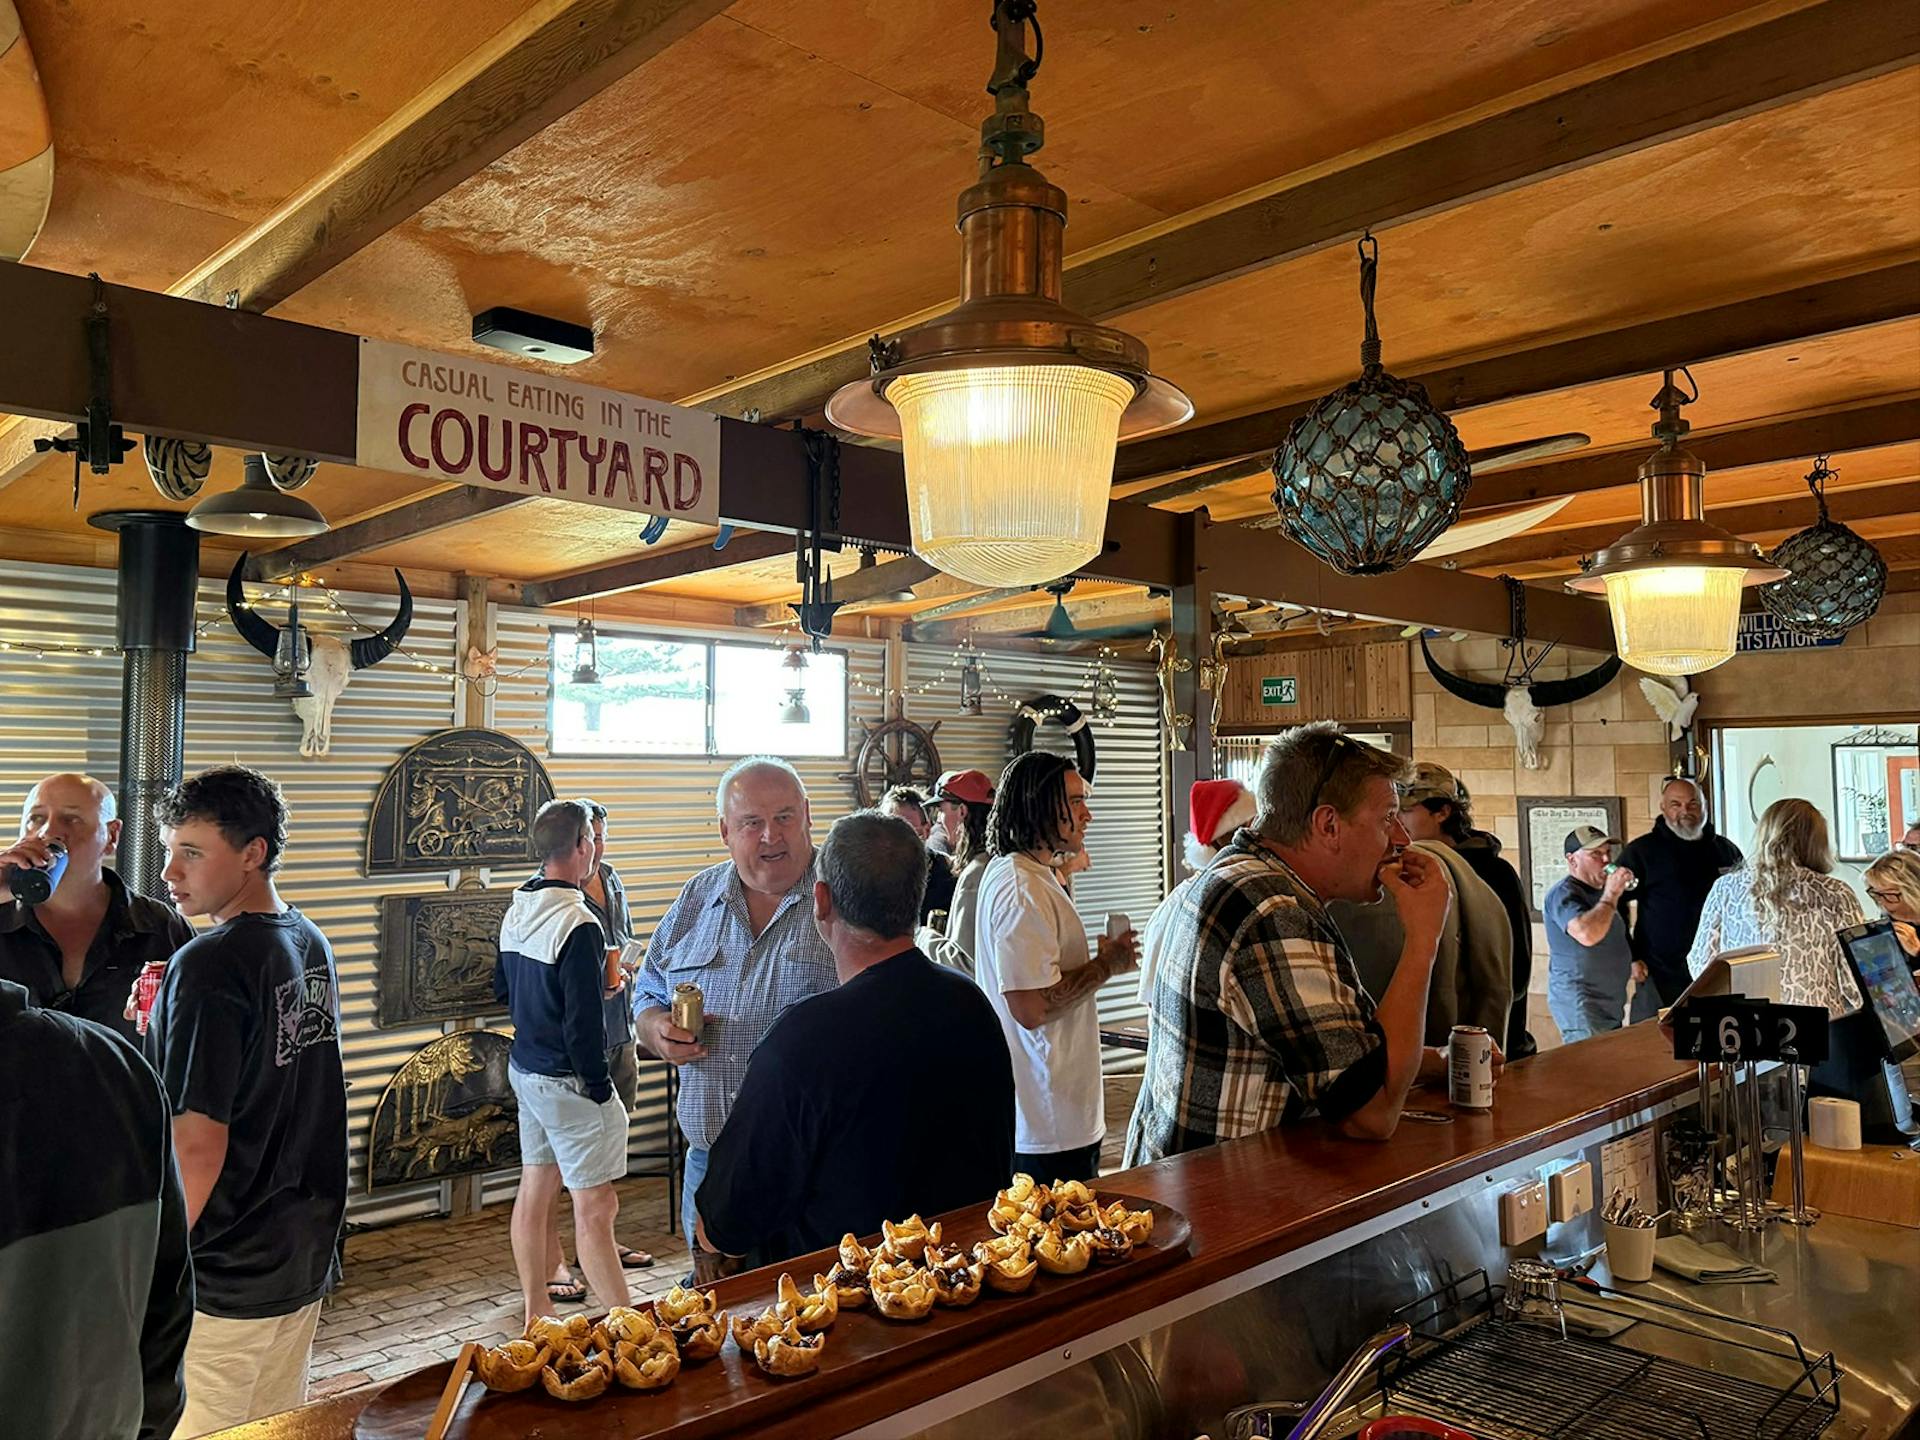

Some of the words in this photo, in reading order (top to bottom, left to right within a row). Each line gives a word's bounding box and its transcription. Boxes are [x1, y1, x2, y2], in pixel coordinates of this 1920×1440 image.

[402, 360, 494, 403] CASUAL
[507, 381, 584, 420] EATING
[601, 400, 623, 428] IN
[633, 407, 672, 438] THE
[398, 403, 702, 511] COURTYARD
[1263, 685, 1282, 697] EXIT
[1718, 1015, 1741, 1054] 6
[1776, 1017, 1798, 1054] 2
